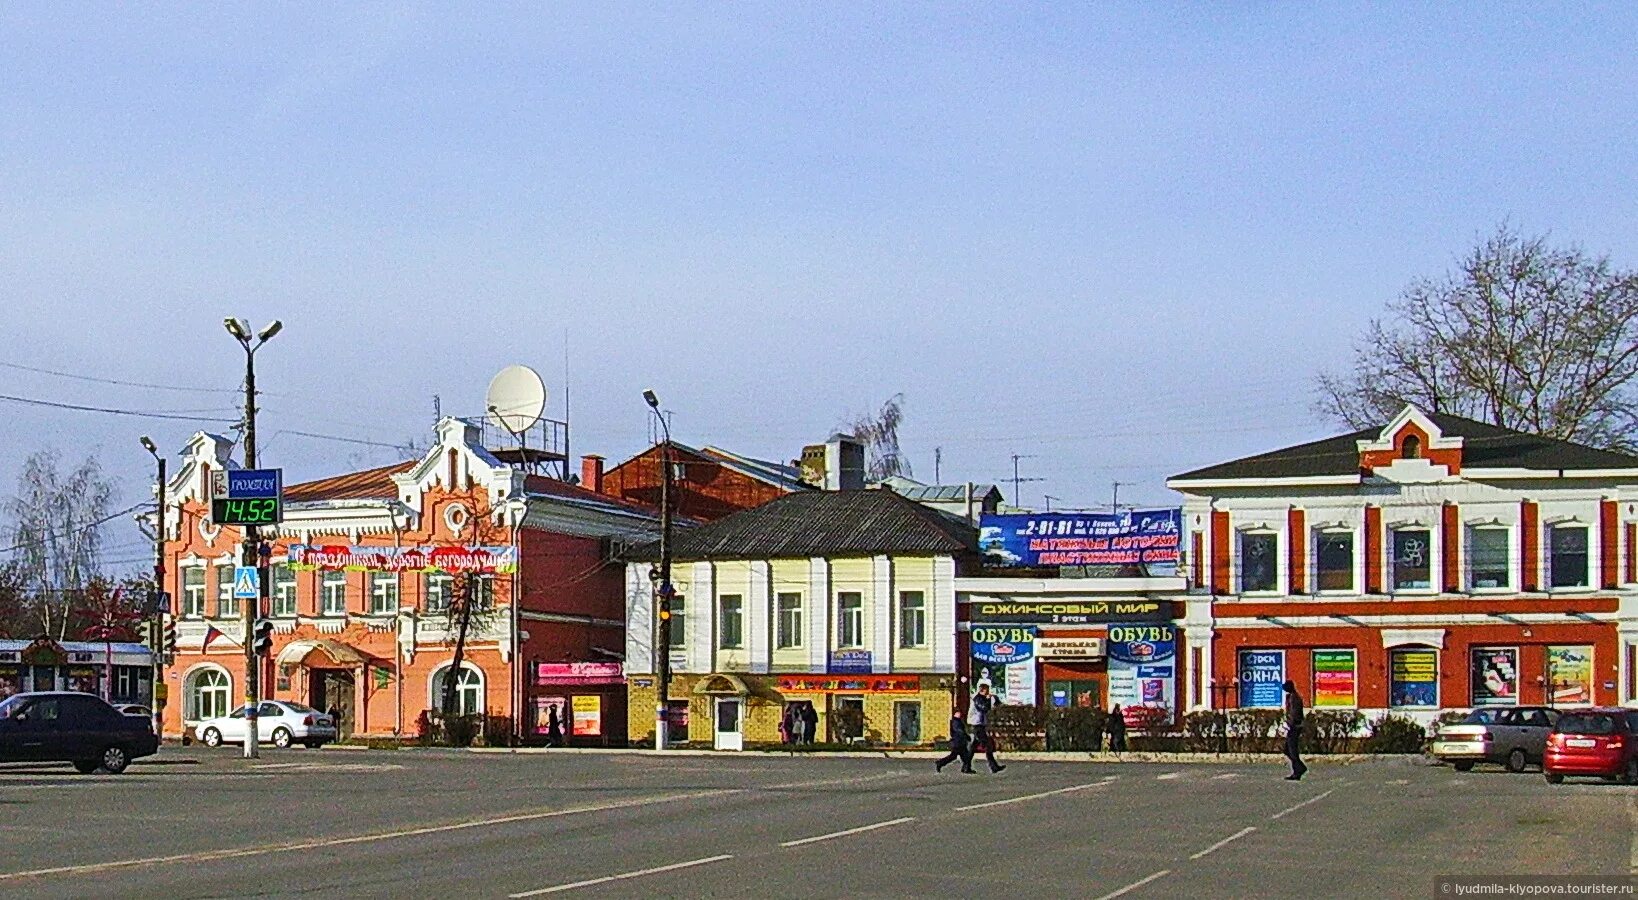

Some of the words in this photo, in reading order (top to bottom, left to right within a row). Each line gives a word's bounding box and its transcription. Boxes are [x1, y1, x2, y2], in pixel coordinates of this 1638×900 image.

[225, 500, 275, 521] 14.52
[982, 602, 1109, 614] ДЖИНСОВЫЙ
[1116, 603, 1159, 614] МИР
[972, 628, 1033, 643] ОБУВЬ
[1109, 626, 1172, 642] ОБУВЬ
[1242, 670, 1281, 682] ОКНА
